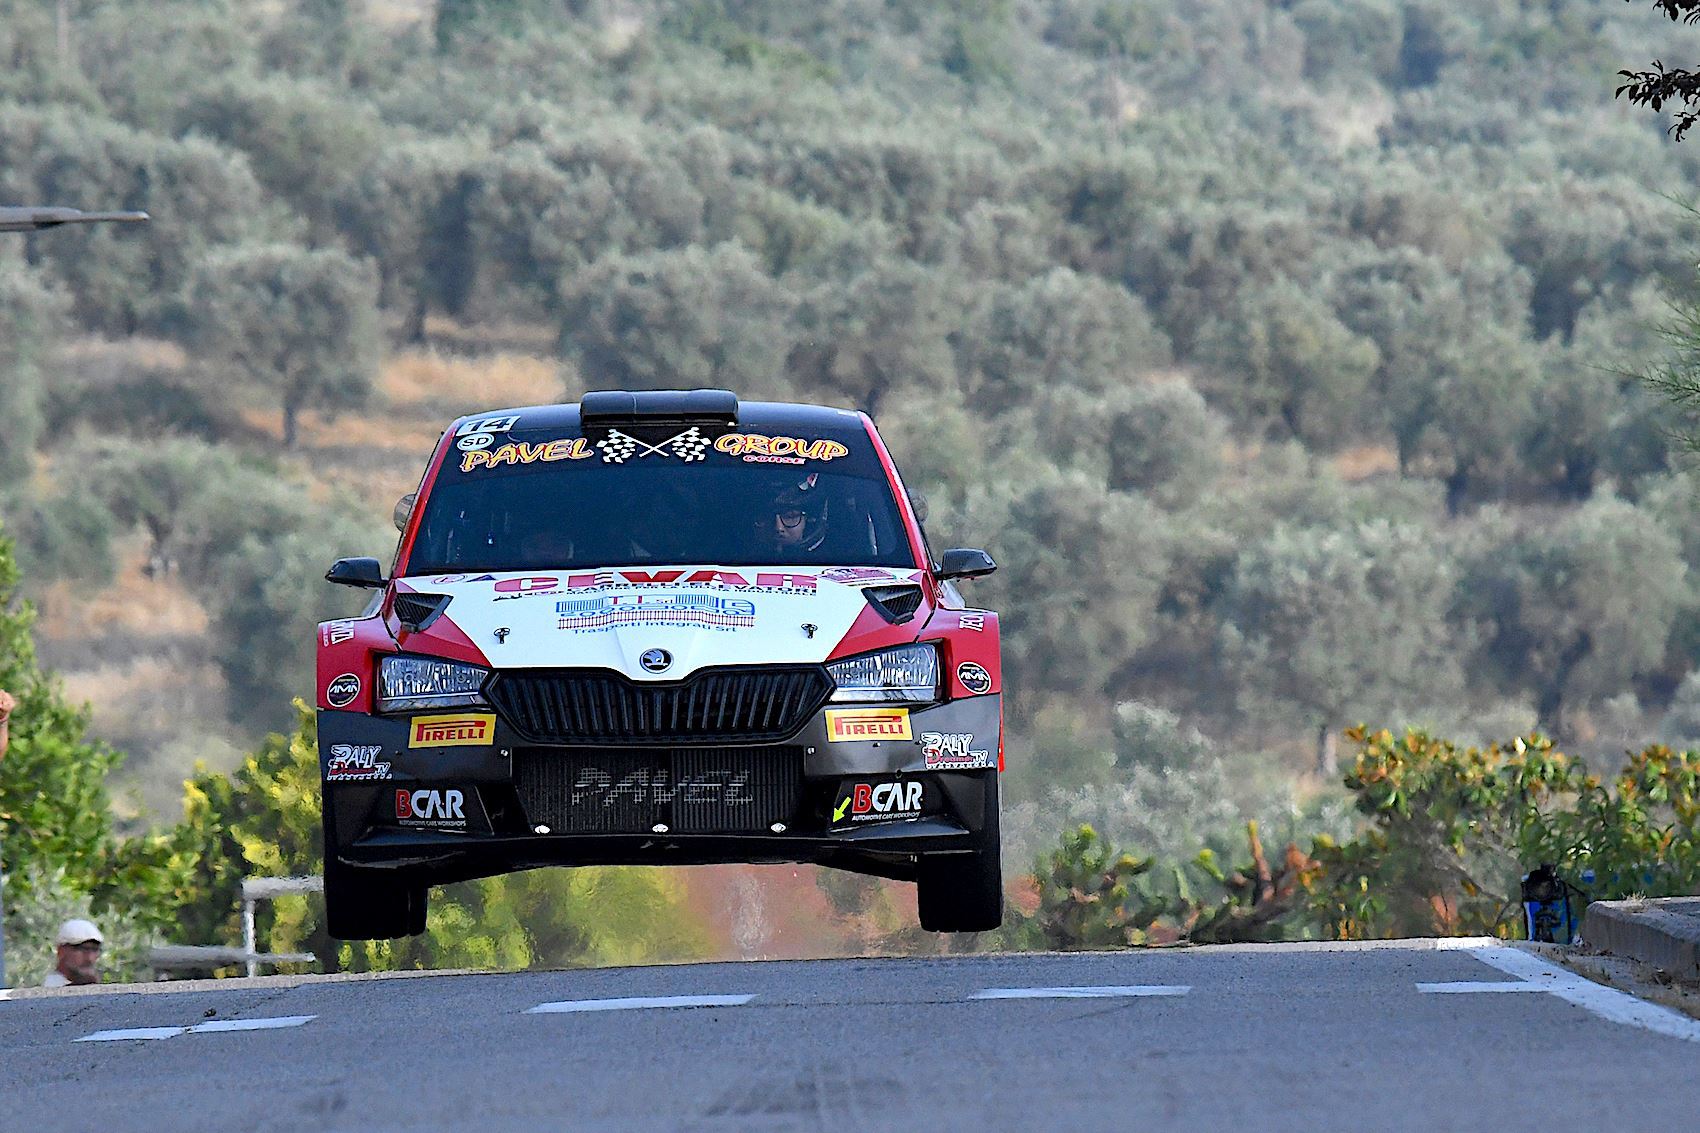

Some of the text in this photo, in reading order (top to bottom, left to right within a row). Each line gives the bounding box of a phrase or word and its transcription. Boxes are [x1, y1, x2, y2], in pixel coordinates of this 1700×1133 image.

[468, 417, 510, 432] 14
[460, 433, 849, 473] PAVEL GROUP
[462, 437, 490, 447] SD
[494, 570, 818, 592] CEVAR
[572, 621, 640, 635] Trasporti
[645, 621, 711, 630] Integrati
[416, 720, 487, 742] PIRELLI
[834, 716, 904, 736] PIRELLI
[920, 732, 974, 758] RALLY
[331, 744, 382, 769] RALLY
[396, 789, 465, 819] BCAR
[852, 781, 923, 813] BCAR
